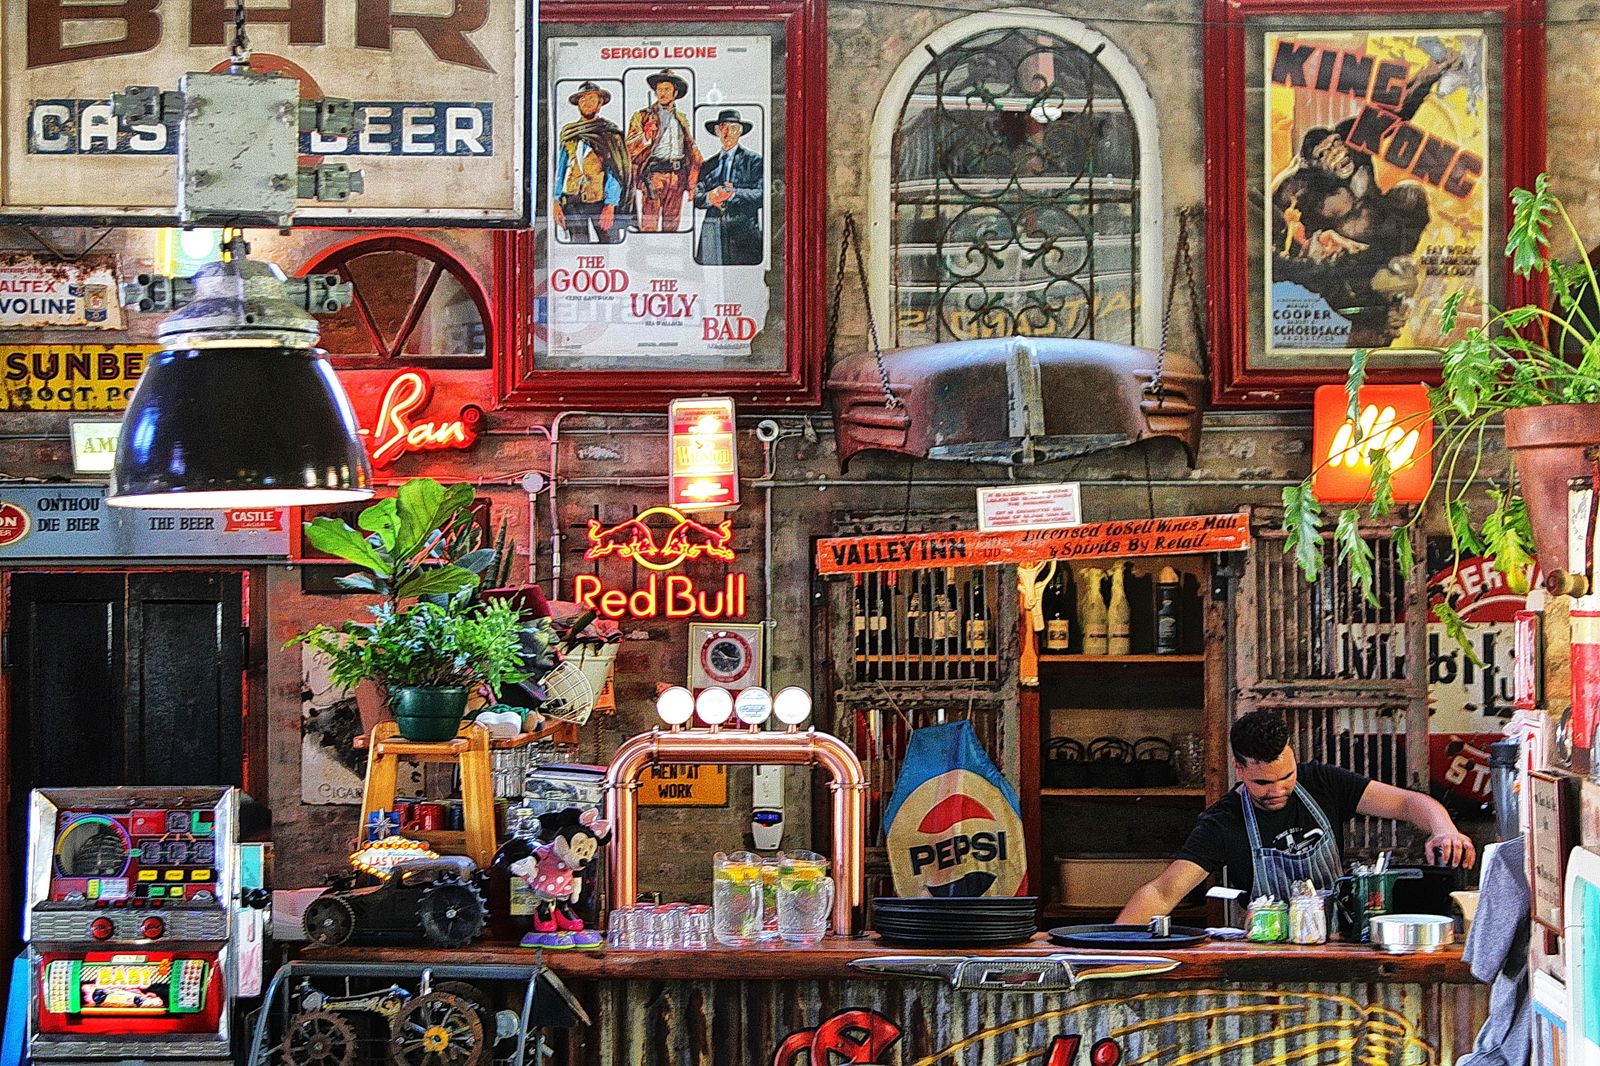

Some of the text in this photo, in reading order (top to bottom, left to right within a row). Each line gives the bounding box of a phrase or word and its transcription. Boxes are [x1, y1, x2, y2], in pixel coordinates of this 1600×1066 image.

[601, 48, 659, 59] SERGIO
[663, 46, 717, 59] LEONE
[1271, 41, 1409, 108] KING
[1345, 105, 1484, 199] KONG
[576, 256, 605, 269] THE
[551, 268, 630, 293] GOOD
[650, 279, 678, 292] THE
[630, 293, 698, 318] UGLY
[713, 303, 742, 317] THE
[1273, 309, 1332, 320] COOPER
[702, 317, 757, 341] BAD
[1274, 325, 1350, 336] SCHOEDSACK
[37, 497, 100, 512] ONTHOU
[149, 516, 214, 531] THE BEER
[231, 510, 275, 523] CASTLE
[37, 517, 100, 532] DIE BIER
[831, 537, 967, 566] VALLEY INN
[1060, 541, 1121, 557] Spirits
[1127, 537, 1150, 552] By
[574, 571, 747, 618] Red Bull
[650, 764, 678, 779] MEN
[658, 783, 694, 799] WORK
[908, 831, 1008, 876] PEPSI
[98, 968, 154, 986] BABY
